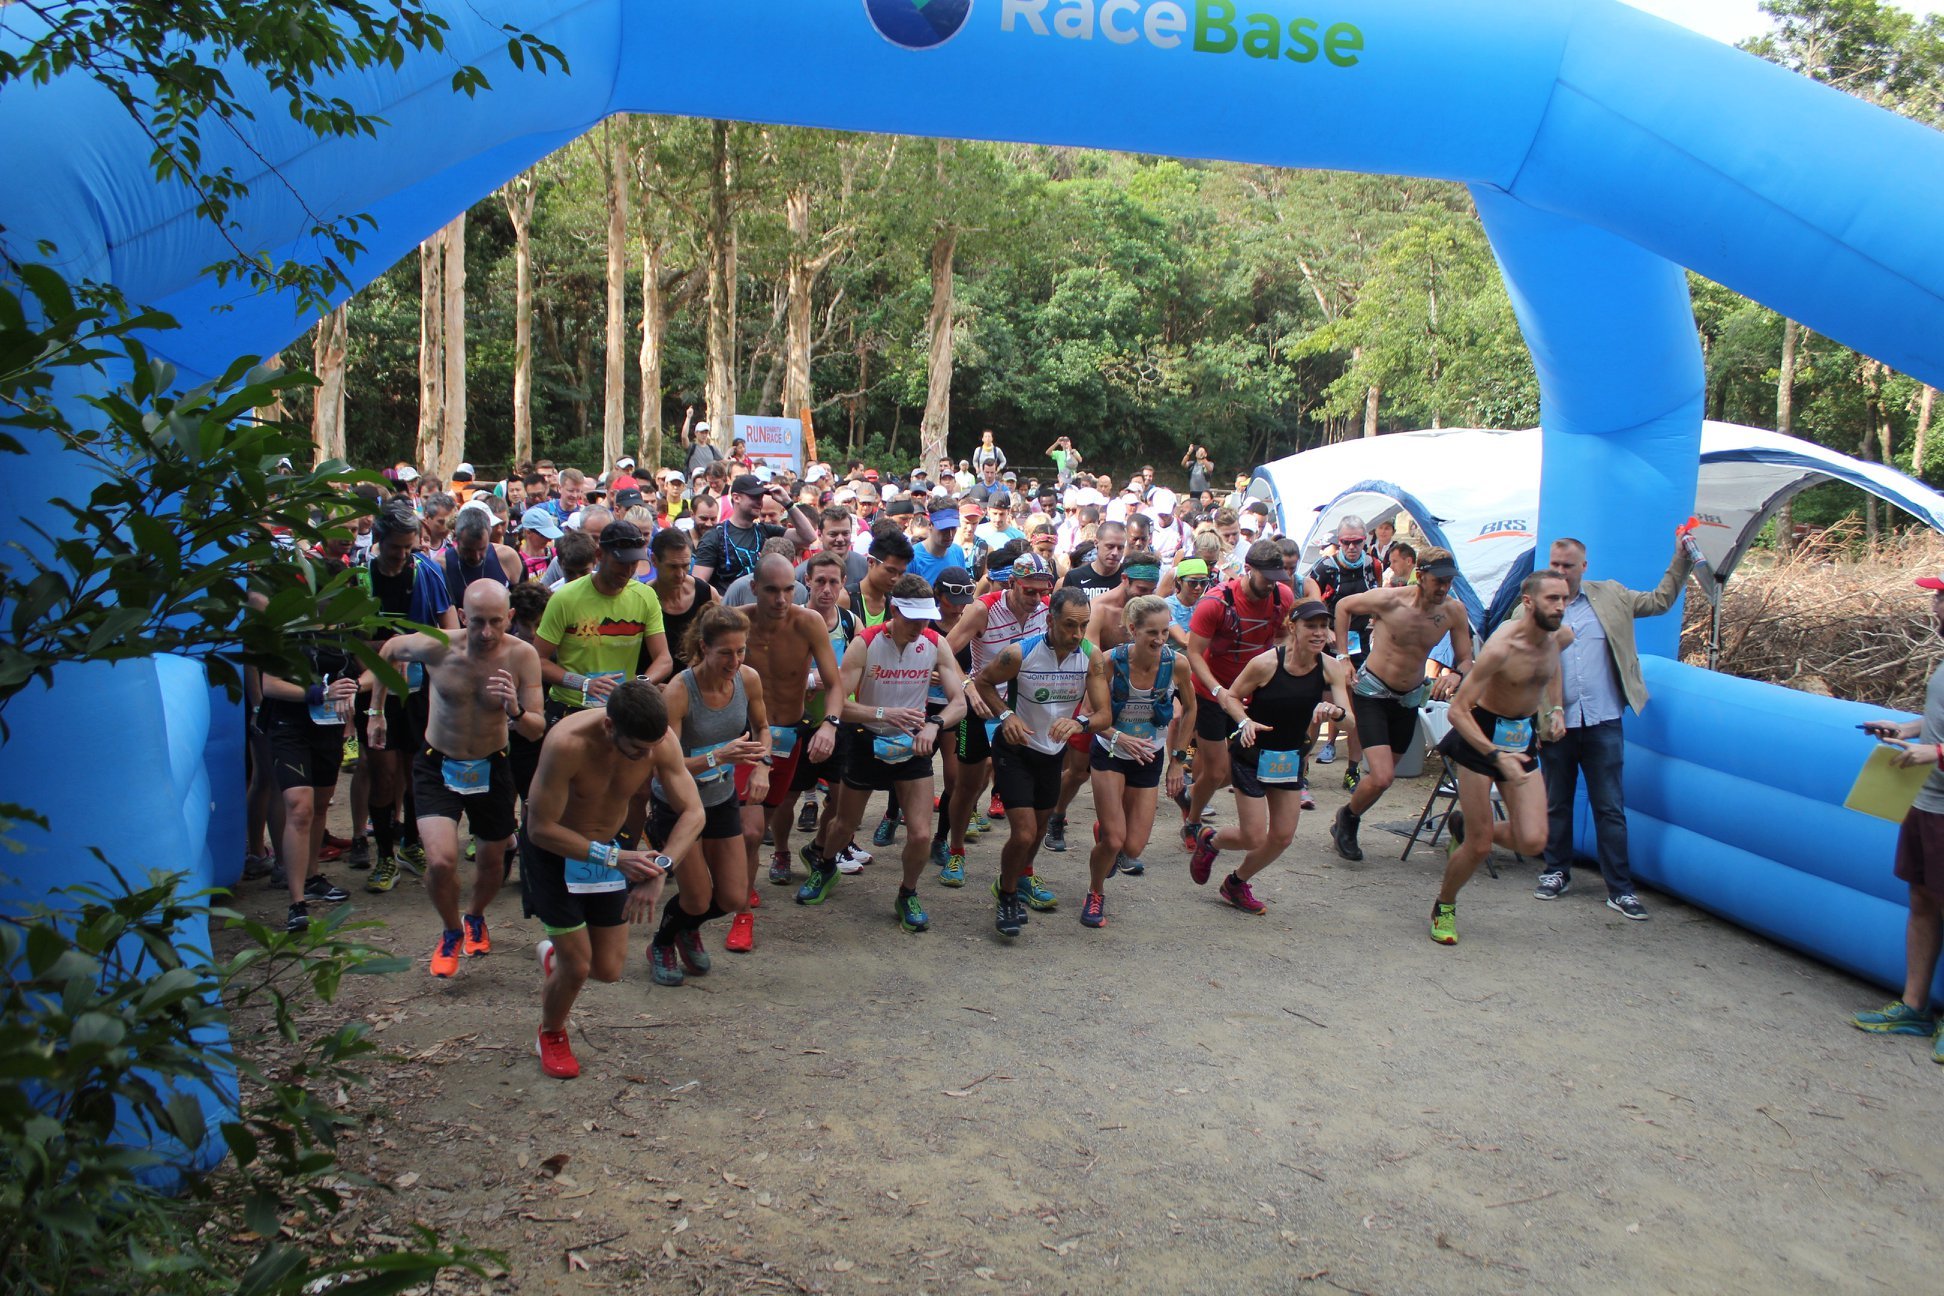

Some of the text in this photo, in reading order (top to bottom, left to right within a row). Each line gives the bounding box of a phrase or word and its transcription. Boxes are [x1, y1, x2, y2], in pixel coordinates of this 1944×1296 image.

[1001, 0, 1364, 68] RaceBase
[746, 425, 766, 443] RUN
[766, 432, 782, 443] RACE
[1479, 519, 1527, 535] BRS
[1269, 762, 1292, 773] 263
